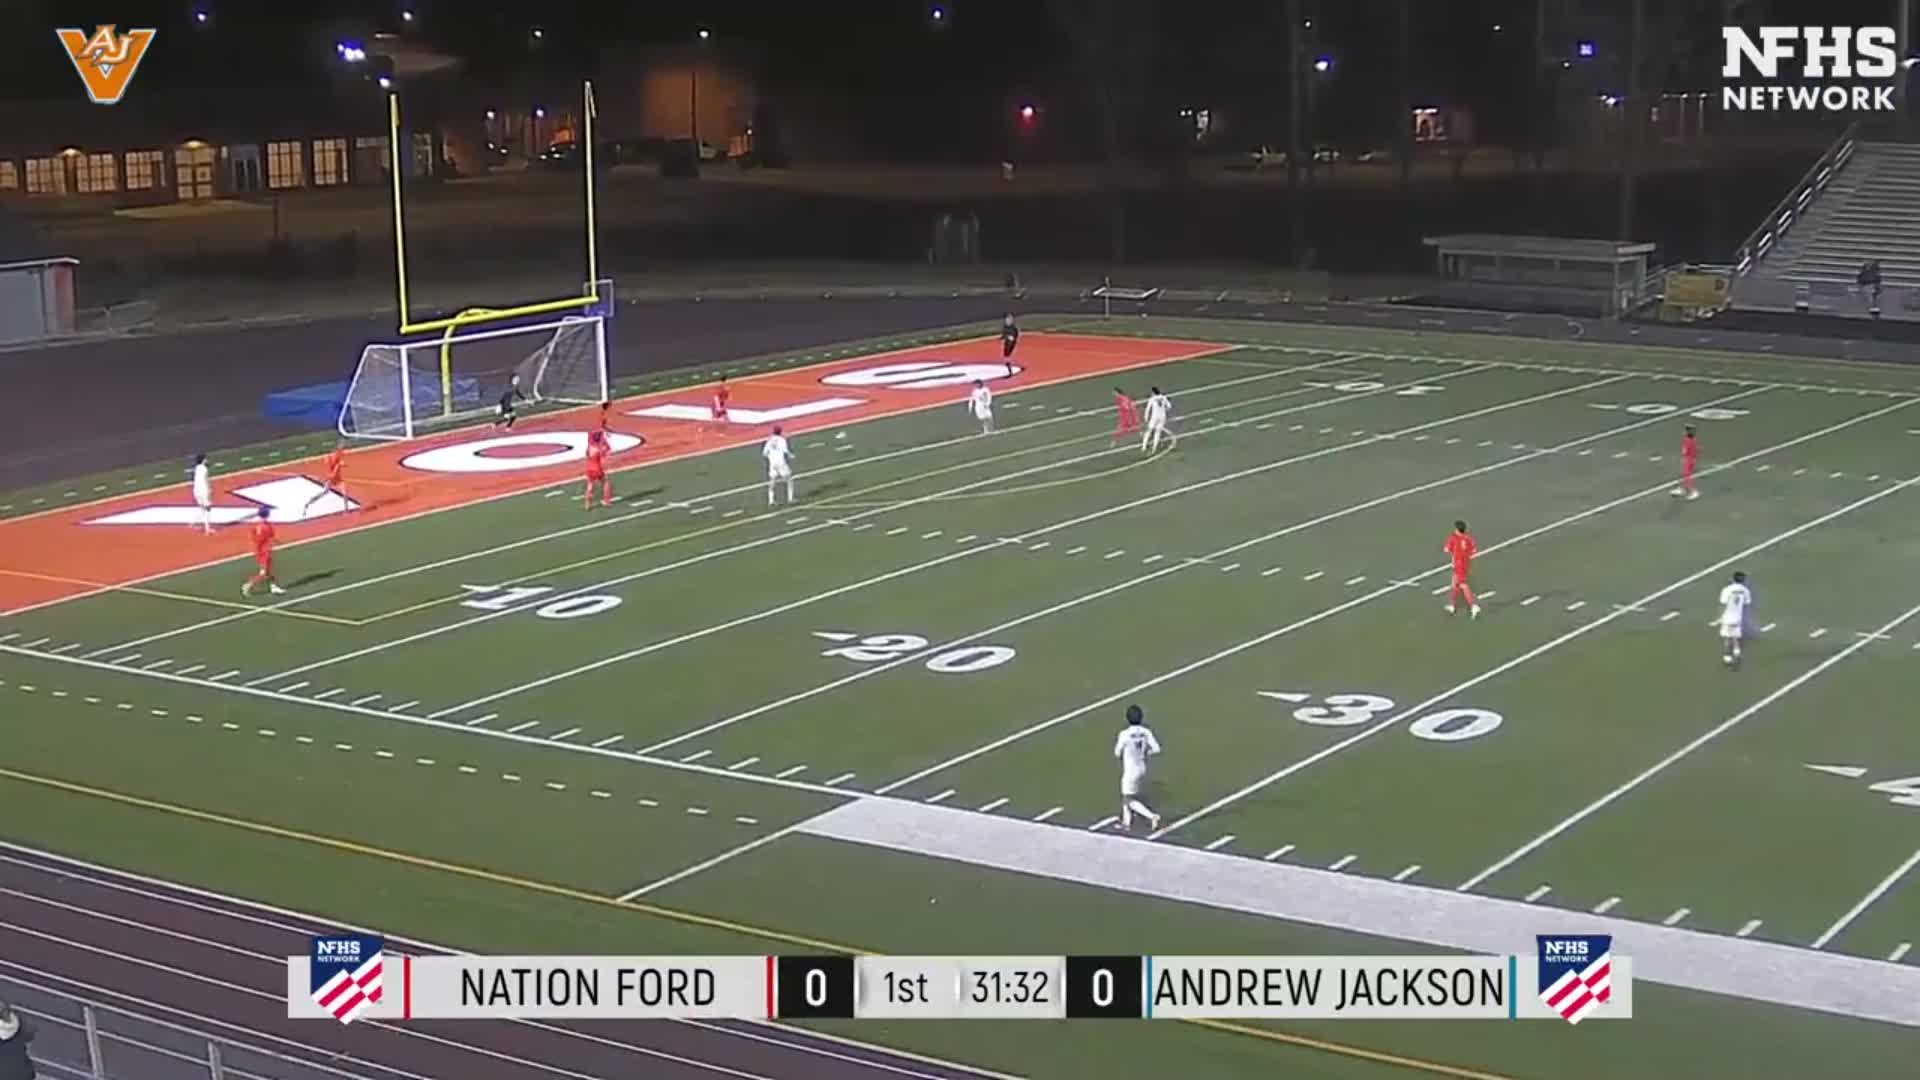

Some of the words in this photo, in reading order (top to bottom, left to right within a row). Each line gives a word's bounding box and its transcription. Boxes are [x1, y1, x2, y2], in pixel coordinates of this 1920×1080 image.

[459, 586, 623, 618] 10
[820, 634, 1016, 672] 20
[1292, 693, 1504, 741] 30
